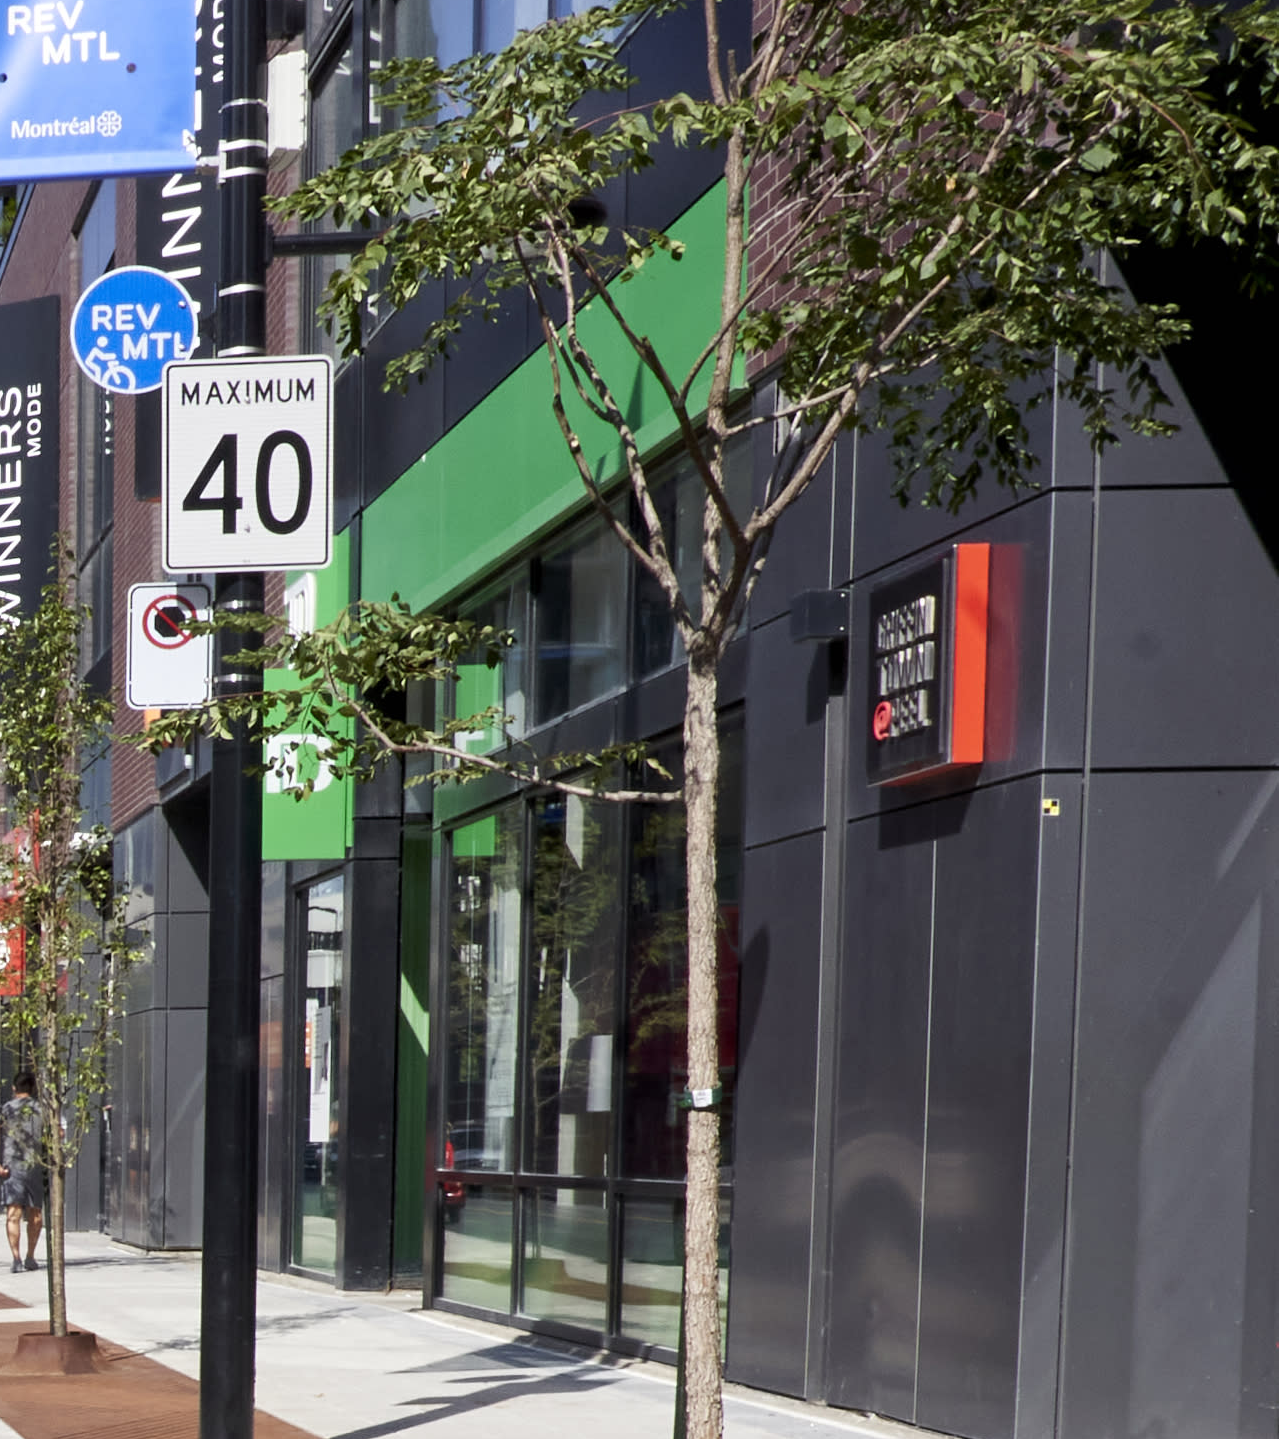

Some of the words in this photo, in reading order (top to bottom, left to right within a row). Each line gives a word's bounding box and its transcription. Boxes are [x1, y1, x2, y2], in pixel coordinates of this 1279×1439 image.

[8, 0, 84, 35] REV
[41, 31, 120, 65] MTL
[11, 116, 95, 140] Montréal
[91, 304, 160, 331] REV
[122, 332, 188, 360] MTL
[180, 378, 316, 406] MAXIMUM
[26, 381, 42, 458] MODE
[181, 428, 314, 536] 40
